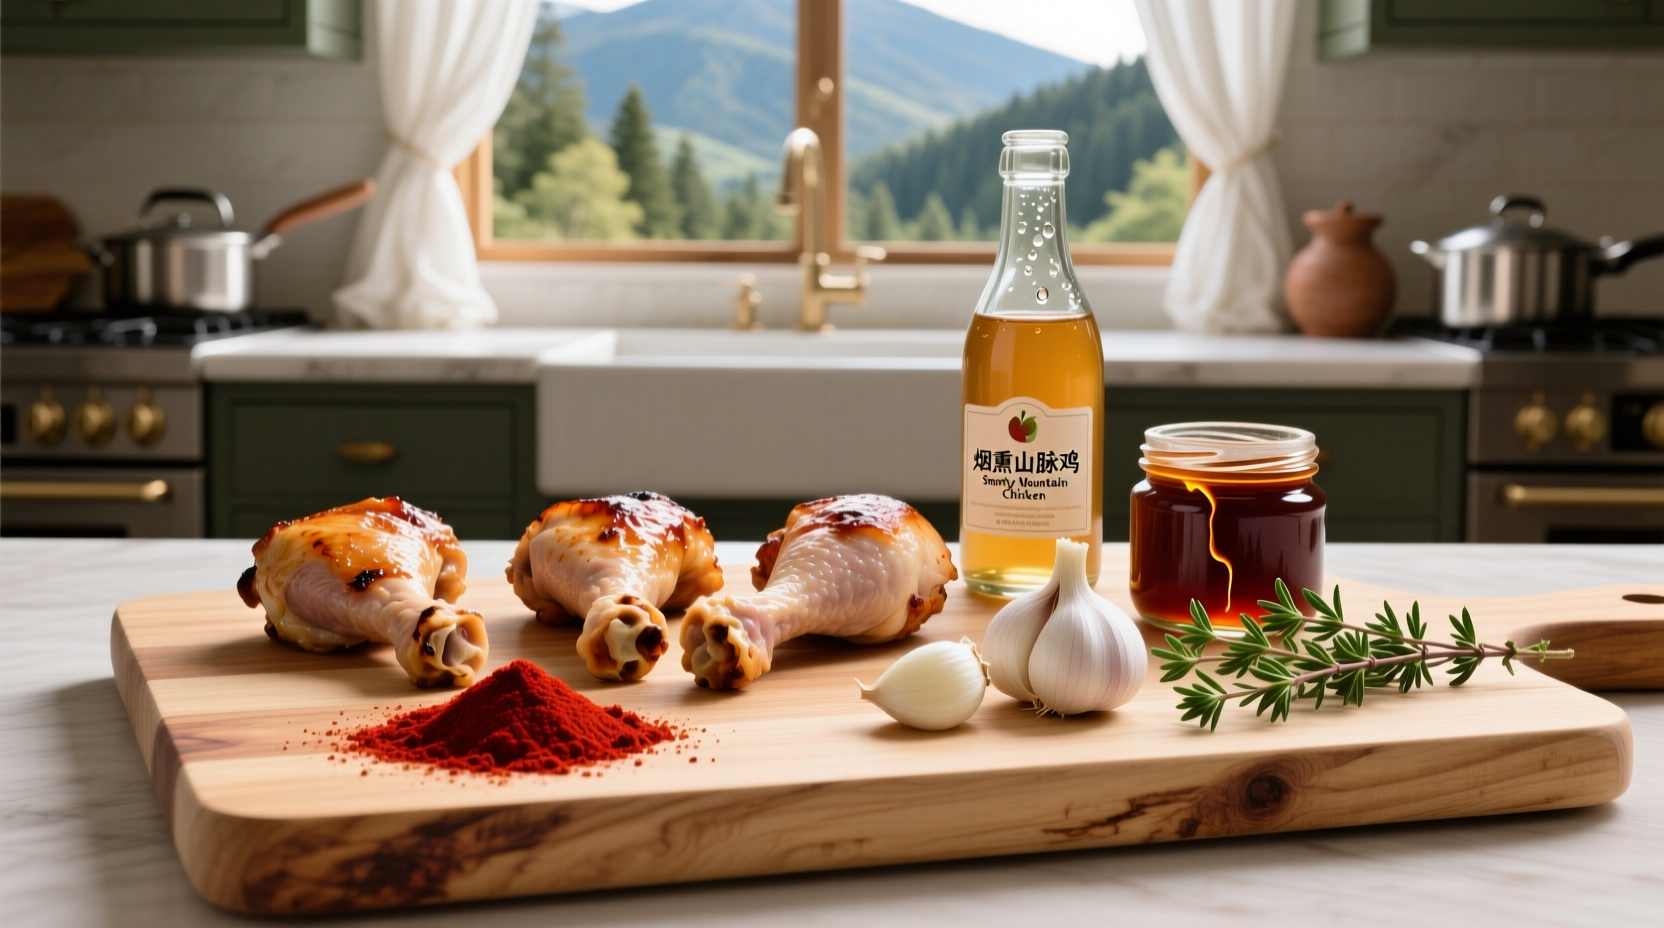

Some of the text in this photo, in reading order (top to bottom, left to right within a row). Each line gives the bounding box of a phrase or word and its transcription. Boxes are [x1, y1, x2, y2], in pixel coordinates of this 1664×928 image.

[973, 448, 1079, 474] 烟熏山脉鸡
